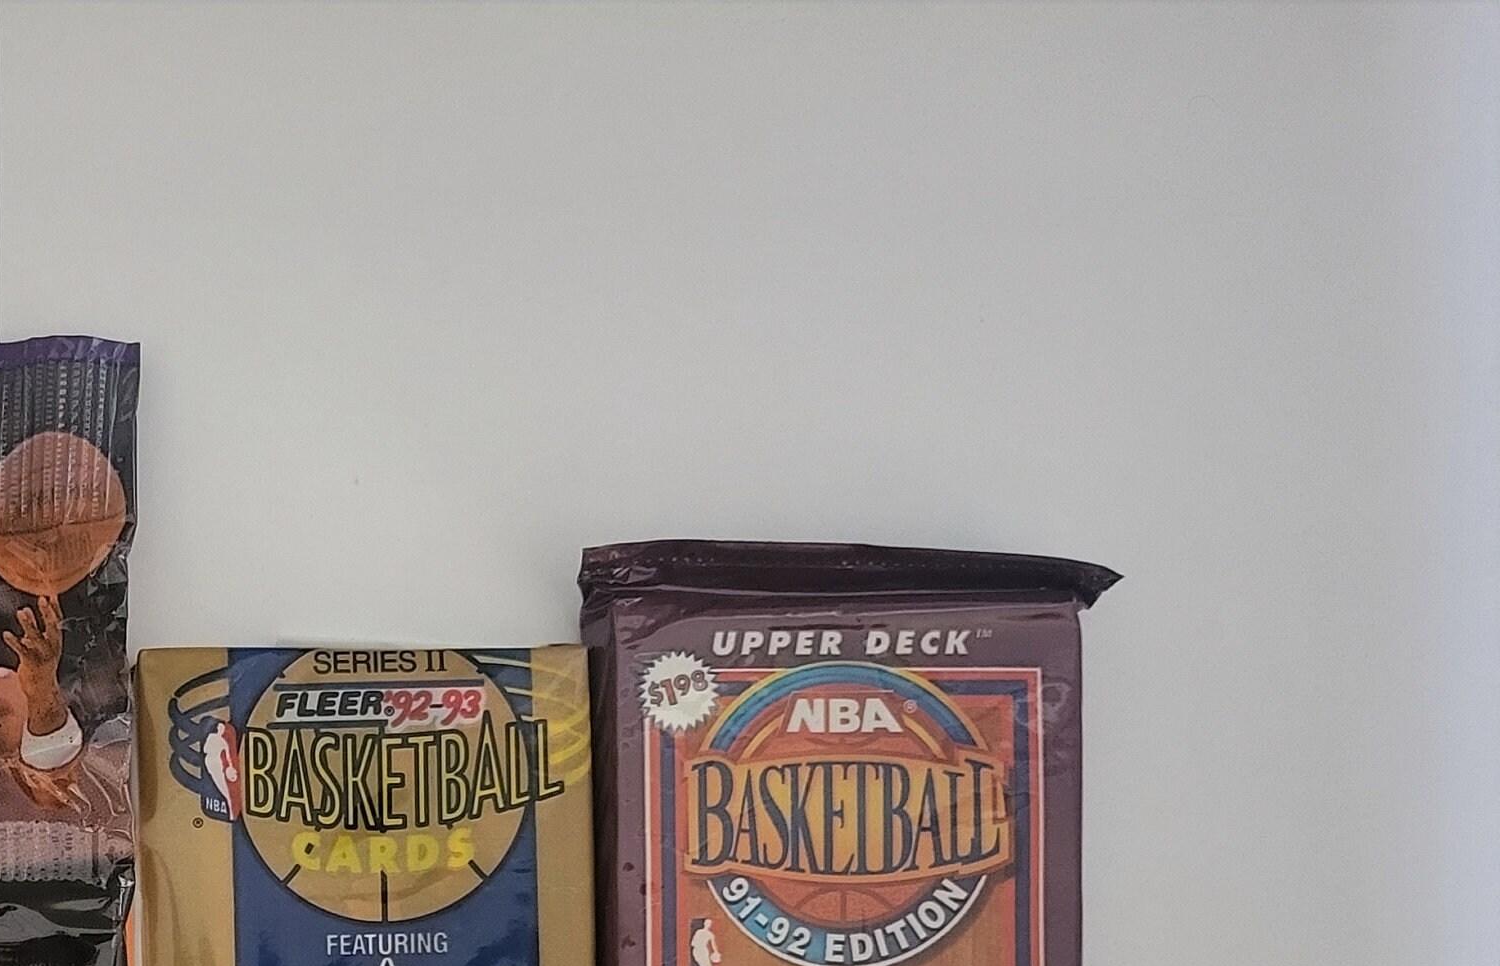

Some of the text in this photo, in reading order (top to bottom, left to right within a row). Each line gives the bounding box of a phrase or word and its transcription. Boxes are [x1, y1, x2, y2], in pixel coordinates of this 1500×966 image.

[712, 631, 843, 656] UPPER
[865, 630, 973, 655] DECK
[313, 649, 448, 674] SERIES II
[276, 691, 384, 717] FLEER
[786, 698, 904, 734] NBA
[244, 709, 565, 831] BASKETBALL
[205, 797, 228, 814] NBA
[691, 757, 1001, 876] BASKETBALL
[292, 828, 476, 874] CARDS
[722, 877, 970, 964] 91-92 EDITION
[326, 932, 448, 955] FEATURING
